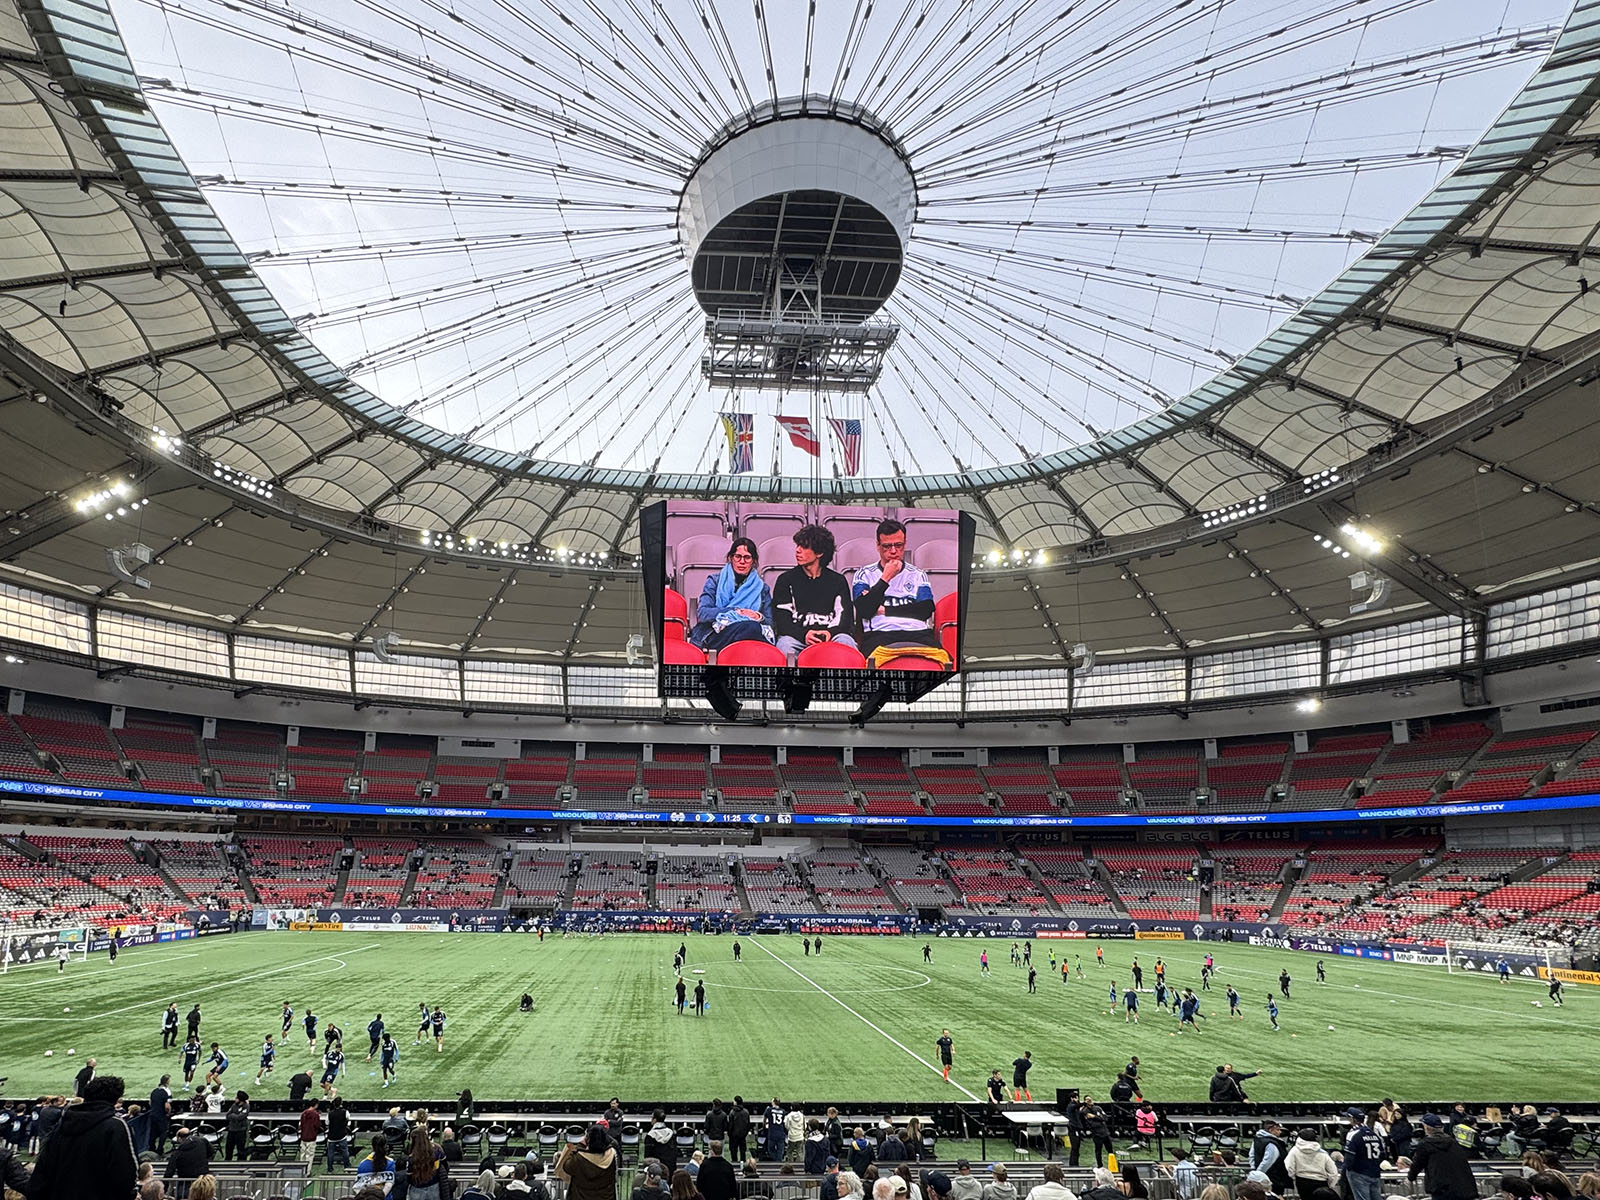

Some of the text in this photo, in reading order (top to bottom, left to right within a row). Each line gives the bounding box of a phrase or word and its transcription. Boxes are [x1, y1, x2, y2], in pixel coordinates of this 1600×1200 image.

[25, 784, 44, 792] VS
[1146, 833, 1174, 841] BLG
[1250, 831, 1290, 840] TELUS
[134, 935, 154, 944] TELUS
[55, 943, 86, 952] LG
[1311, 943, 1332, 952] TELUS
[1396, 953, 1415, 962] MNP
[1417, 954, 1438, 964] MNP
[1545, 970, 1594, 981] Cntinental
[772, 1113, 783, 1125] 13
[1365, 1142, 1380, 1159] 13
